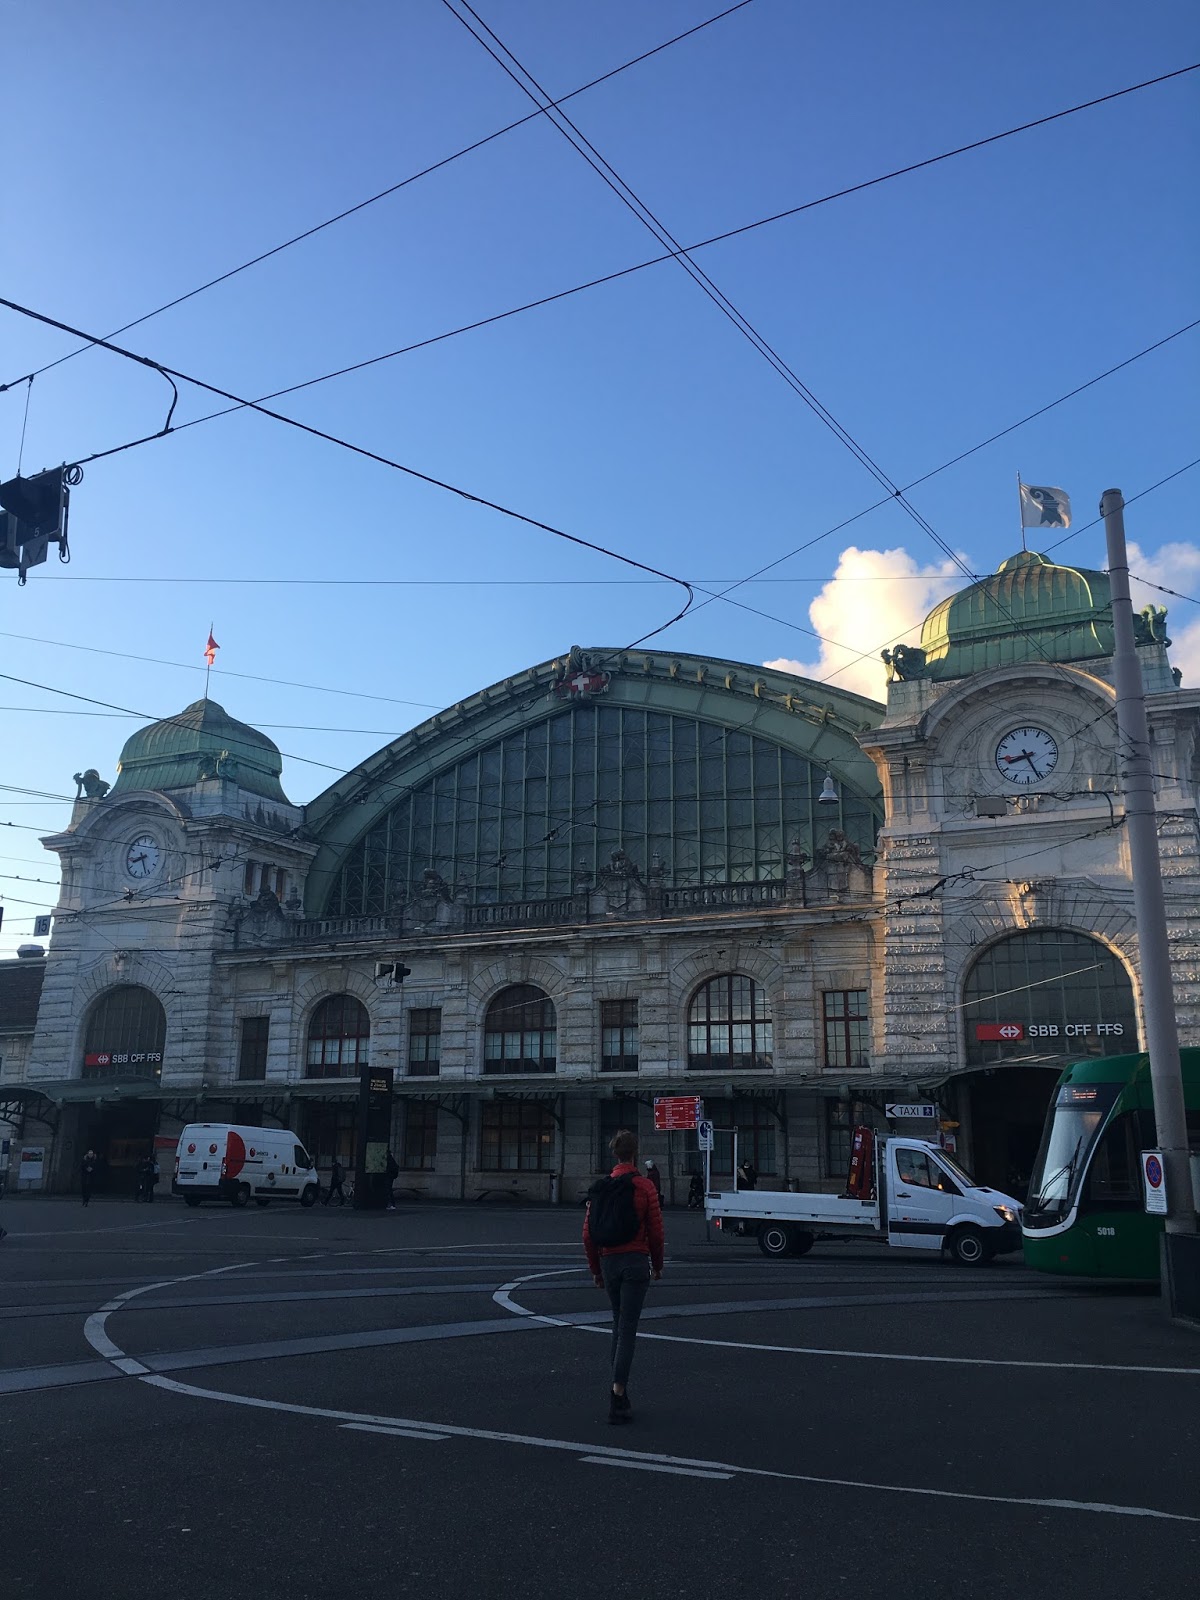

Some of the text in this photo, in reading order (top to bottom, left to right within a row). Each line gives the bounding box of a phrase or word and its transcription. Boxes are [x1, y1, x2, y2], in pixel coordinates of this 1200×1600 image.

[37, 919, 48, 933] 15
[1028, 1023, 1124, 1037] SBB CFF FFS
[112, 1052, 161, 1063] SBB CFF FFS
[898, 1106, 920, 1116] TAXI
[1097, 1226, 1116, 1236] 5018
